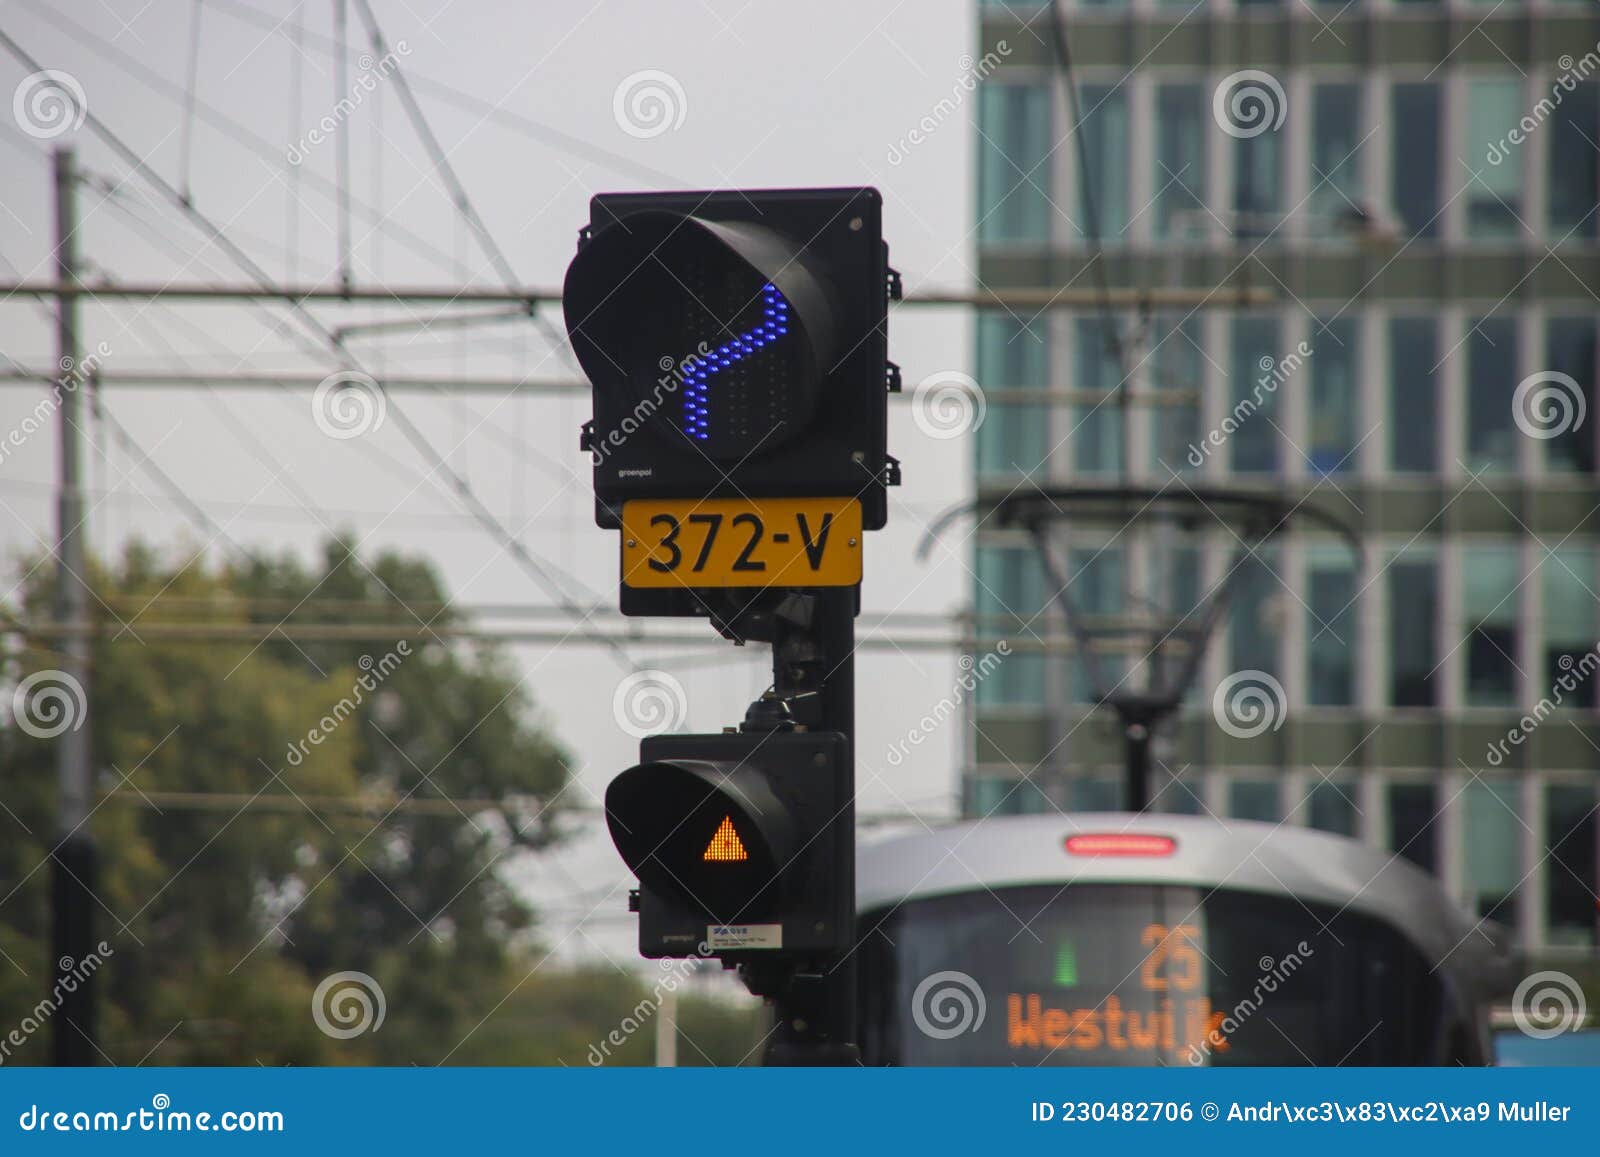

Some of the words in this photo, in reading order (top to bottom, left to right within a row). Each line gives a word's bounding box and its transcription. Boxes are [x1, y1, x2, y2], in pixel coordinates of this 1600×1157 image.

[648, 513, 833, 573] 372-V
[1140, 923, 1200, 991] 25
[1007, 993, 1232, 1062] Westwijk
